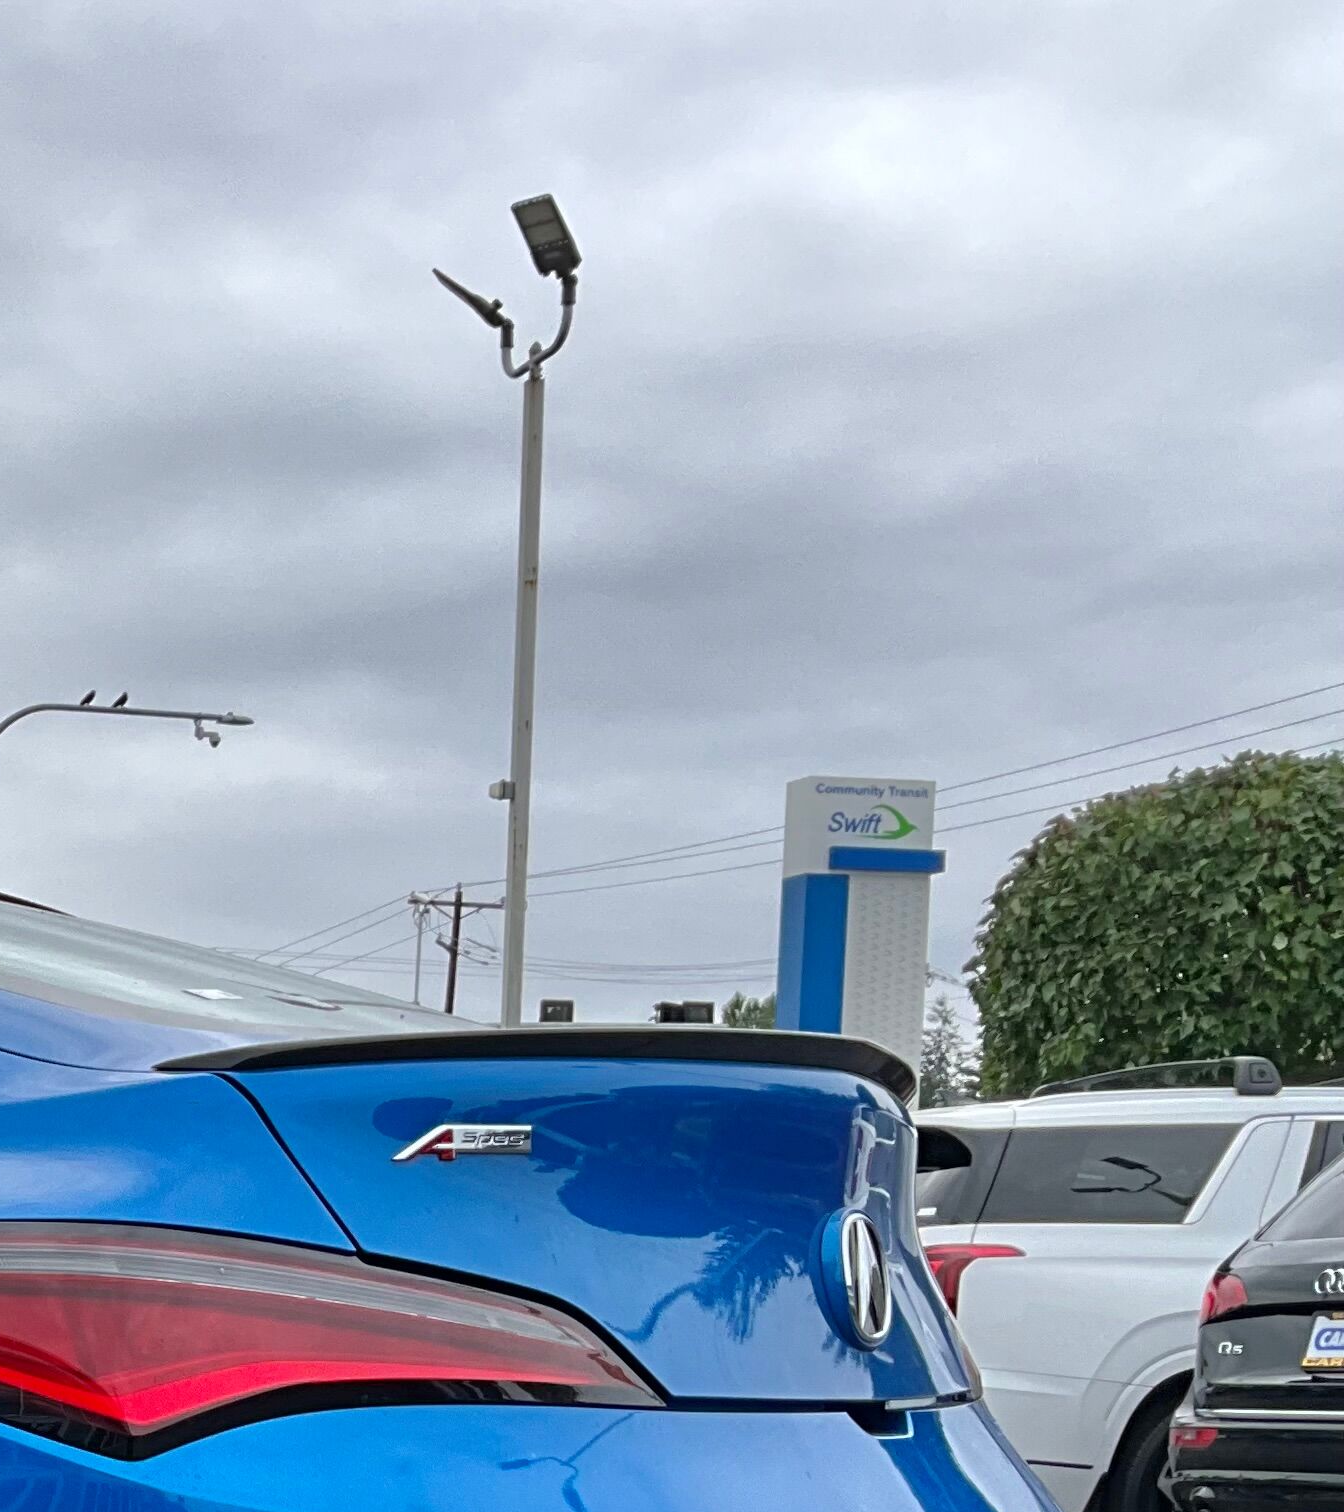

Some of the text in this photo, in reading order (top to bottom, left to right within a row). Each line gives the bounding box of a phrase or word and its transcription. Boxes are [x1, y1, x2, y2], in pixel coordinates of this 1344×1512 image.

[815, 783, 929, 799] Community Transit
[828, 811, 882, 834] Swift
